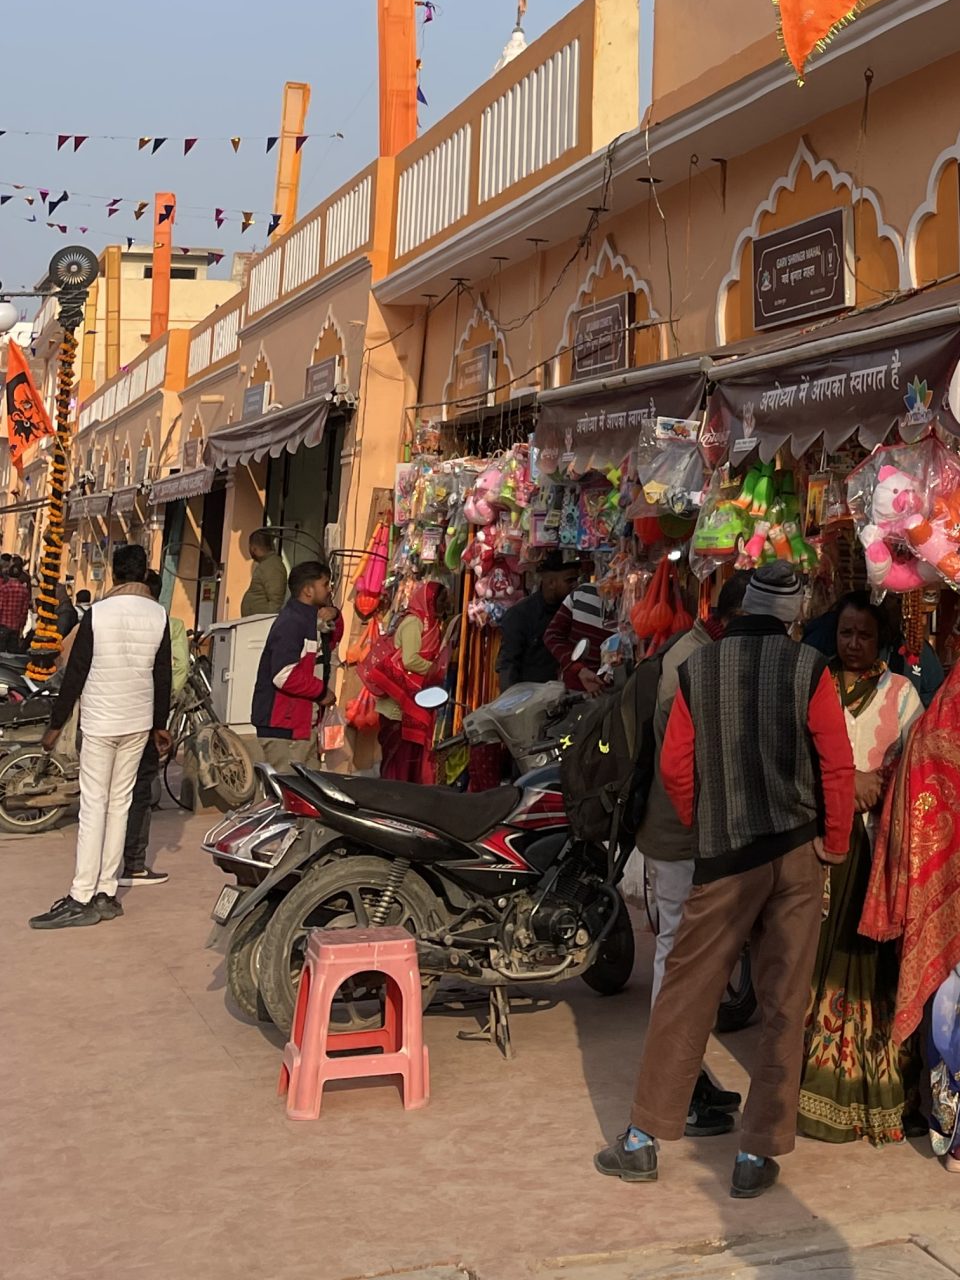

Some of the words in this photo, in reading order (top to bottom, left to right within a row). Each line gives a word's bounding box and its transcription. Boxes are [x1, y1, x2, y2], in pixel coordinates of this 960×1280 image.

[760, 381, 798, 412] अयोध्या
[799, 375, 810, 405] में
[811, 373, 847, 402] आपका
[850, 365, 888, 395] स्वागत
[891, 349, 901, 390] है
